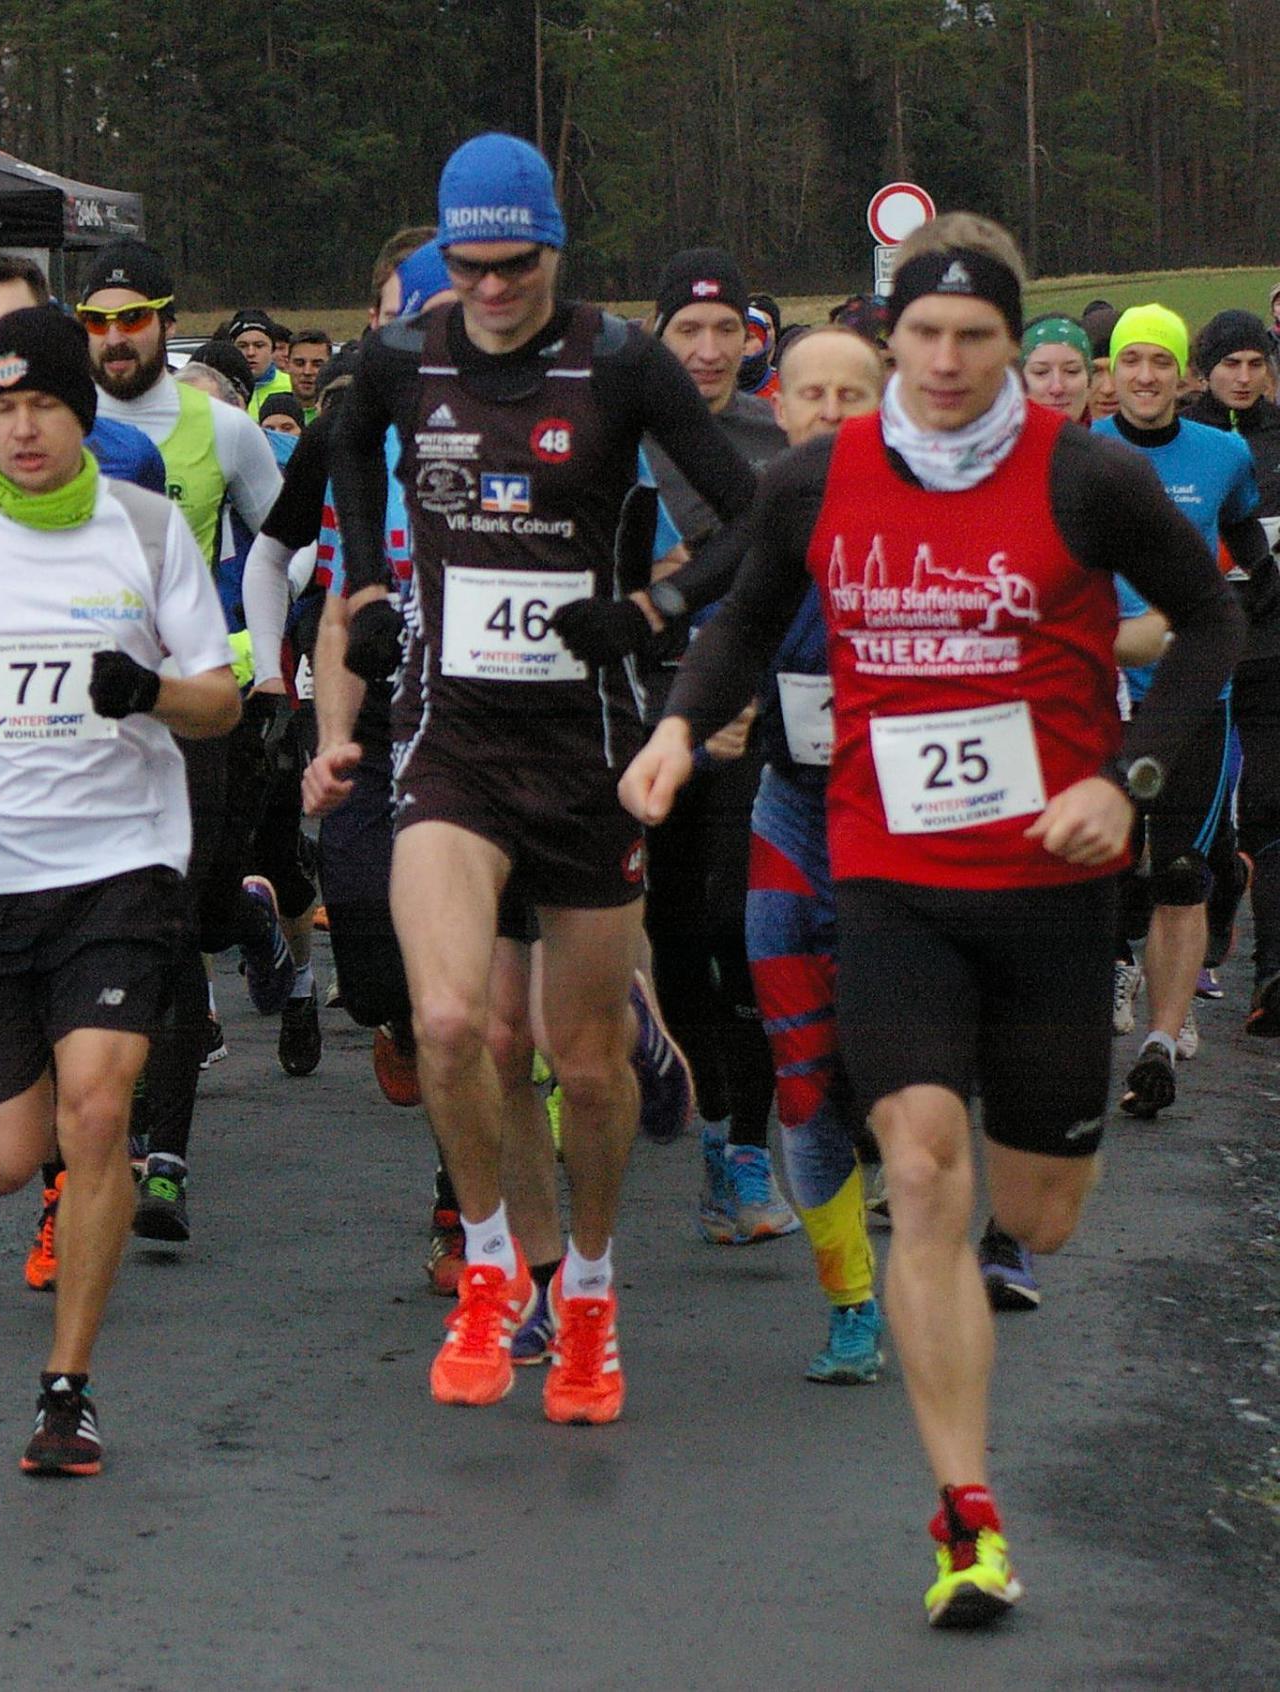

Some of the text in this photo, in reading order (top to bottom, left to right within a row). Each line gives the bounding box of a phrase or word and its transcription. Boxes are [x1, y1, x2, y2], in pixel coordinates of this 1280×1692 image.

[539, 430, 570, 453] 48
[446, 512, 574, 537] VR-Bank Coburg
[833, 587, 989, 611] TSV 1860 Staffelstein
[487, 598, 550, 641] 46
[482, 651, 558, 664] INTERSPORT
[476, 664, 550, 676] WOHLLEBEN
[10, 661, 72, 704] 77
[8, 714, 85, 726] INTERSPORT
[4, 728, 77, 739] WOHLLEBEN
[919, 738, 989, 789] 25
